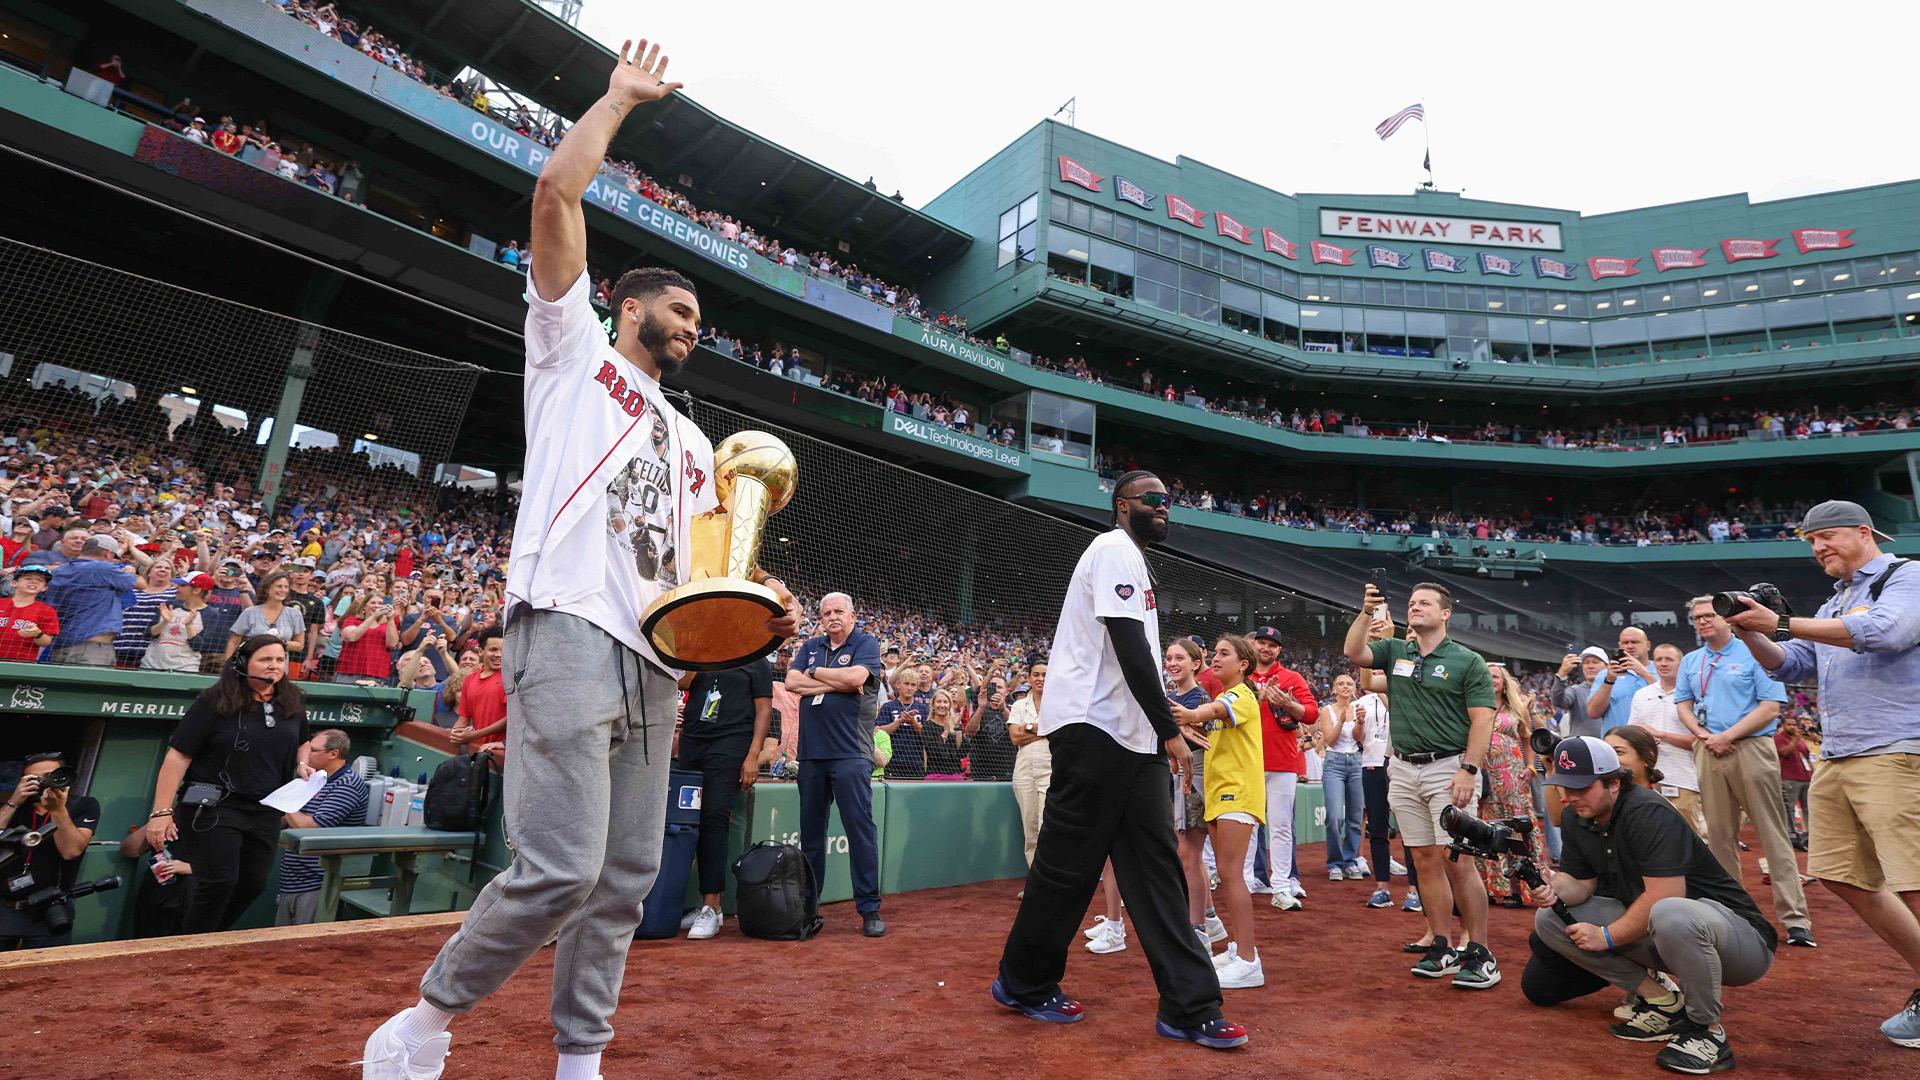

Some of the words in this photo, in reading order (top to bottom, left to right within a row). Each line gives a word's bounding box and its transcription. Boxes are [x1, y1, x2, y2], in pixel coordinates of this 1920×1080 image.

[471, 121, 520, 158] OUR
[638, 204, 748, 269] CEREMONIES
[1338, 215, 1450, 237] FENWAY
[1470, 223, 1545, 243] PARK
[921, 333, 957, 354] AURA
[959, 346, 1005, 373] PAVILION
[594, 360, 645, 418] RED
[686, 450, 706, 498] SX
[894, 418, 928, 440] DELL
[927, 428, 993, 458] Technologies
[995, 448, 1020, 467] Level
[635, 457, 669, 496] CELTIC
[641, 484, 659, 514] 0
[101, 701, 187, 716] MERRILL
[305, 710, 336, 721] RILL
